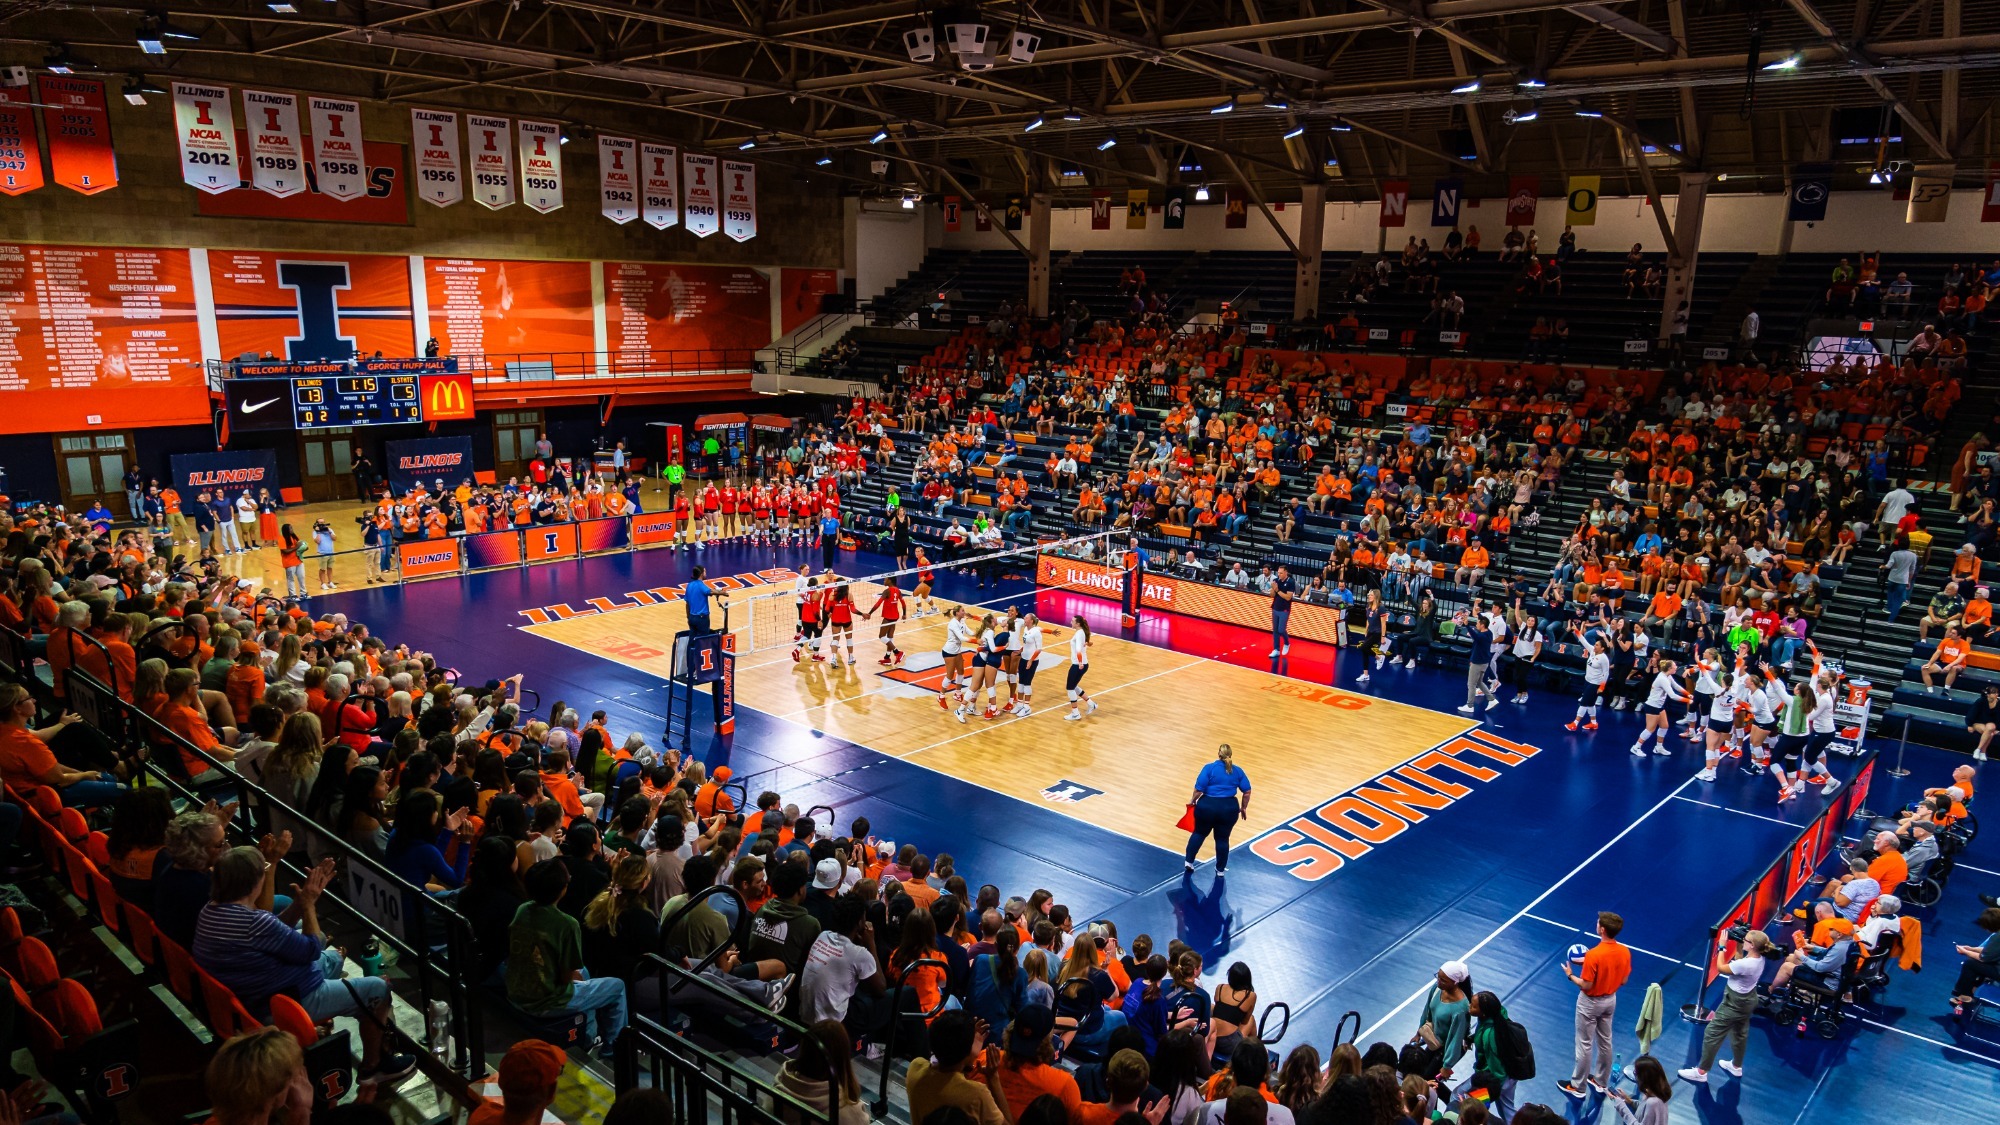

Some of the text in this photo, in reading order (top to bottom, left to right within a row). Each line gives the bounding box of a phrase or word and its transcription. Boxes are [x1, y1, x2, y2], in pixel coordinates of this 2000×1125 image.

[45, 80, 97, 93] ILLINOIS
[178, 86, 224, 99] ILLINOIS
[248, 94, 292, 106] ILLINOIS
[313, 101, 355, 112] ILLINOIS
[60, 115, 93, 125] 1952
[416, 112, 453, 122] ILLINOIS
[471, 118, 506, 128] ILLINOIS
[522, 124, 556, 133] ILLINOIS
[61, 126, 96, 137] 2005
[190, 129, 222, 140] NCAA
[259, 135, 289, 145] NCAA
[324, 141, 351, 150] NCAA
[602, 139, 632, 148] ILLINOIS
[424, 150, 450, 159] NCAA
[644, 146, 673, 155] ILLINOIS
[188, 151, 230, 166] 2012
[256, 156, 297, 170] 1989
[479, 154, 502, 164] NCAA
[529, 159, 552, 168] NCAA
[686, 156, 714, 165] ILLINOIS
[321, 162, 358, 175] 1958
[726, 163, 752, 172] ILLINOIS
[422, 170, 455, 182] 1956
[477, 174, 507, 186] 1955
[607, 172, 628, 181] NCAA
[526, 178, 557, 190] 1950
[649, 179, 668, 187] NCAA
[605, 190, 632, 201] 1942
[690, 188, 710, 196] NCAA
[1912, 184, 1948, 202] P
[647, 197, 672, 207] 1941
[730, 194, 748, 202] NCAA
[1384, 192, 1405, 215] N
[1438, 190, 1456, 216] N
[1568, 189, 1596, 212] O
[688, 205, 714, 216] 1940
[1094, 201, 1107, 218] M
[1130, 202, 1146, 217] M
[728, 210, 751, 221] 1939
[155, 285, 176, 293] AWARD
[132, 330, 166, 338] OLYMPIANS
[242, 366, 287, 374] WELCOME
[402, 362, 423, 370] HUFF
[352, 378, 376, 391] 1:15
[308, 389, 321, 402] 13
[406, 386, 413, 399] 5
[306, 412, 313, 422] 0
[320, 411, 327, 421] 2
[394, 408, 398, 417] 1
[411, 407, 418, 417] 0
[400, 453, 462, 469] ILLINOIS
[189, 467, 265, 486] ILLINOIS
[203, 484, 254, 492] VOEYBALL
[636, 522, 673, 534] ILLINOIS
[545, 533, 558, 553] I
[407, 552, 452, 566] ILLINOIS
[1067, 569, 1124, 592] ILLINOIS
[1140, 584, 1172, 602] TATE
[518, 567, 799, 624] ILLINOIS
[701, 648, 713, 671] I
[723, 657, 732, 716] ILLINOIS
[1726, 695, 1732, 703] 2
[1855, 690, 1862, 698] G
[1249, 729, 1543, 881] ILLINOIS
[370, 883, 399, 920] 110
[756, 925, 773, 935] FACE
[104, 1066, 129, 1096] I
[322, 1072, 344, 1099] I
